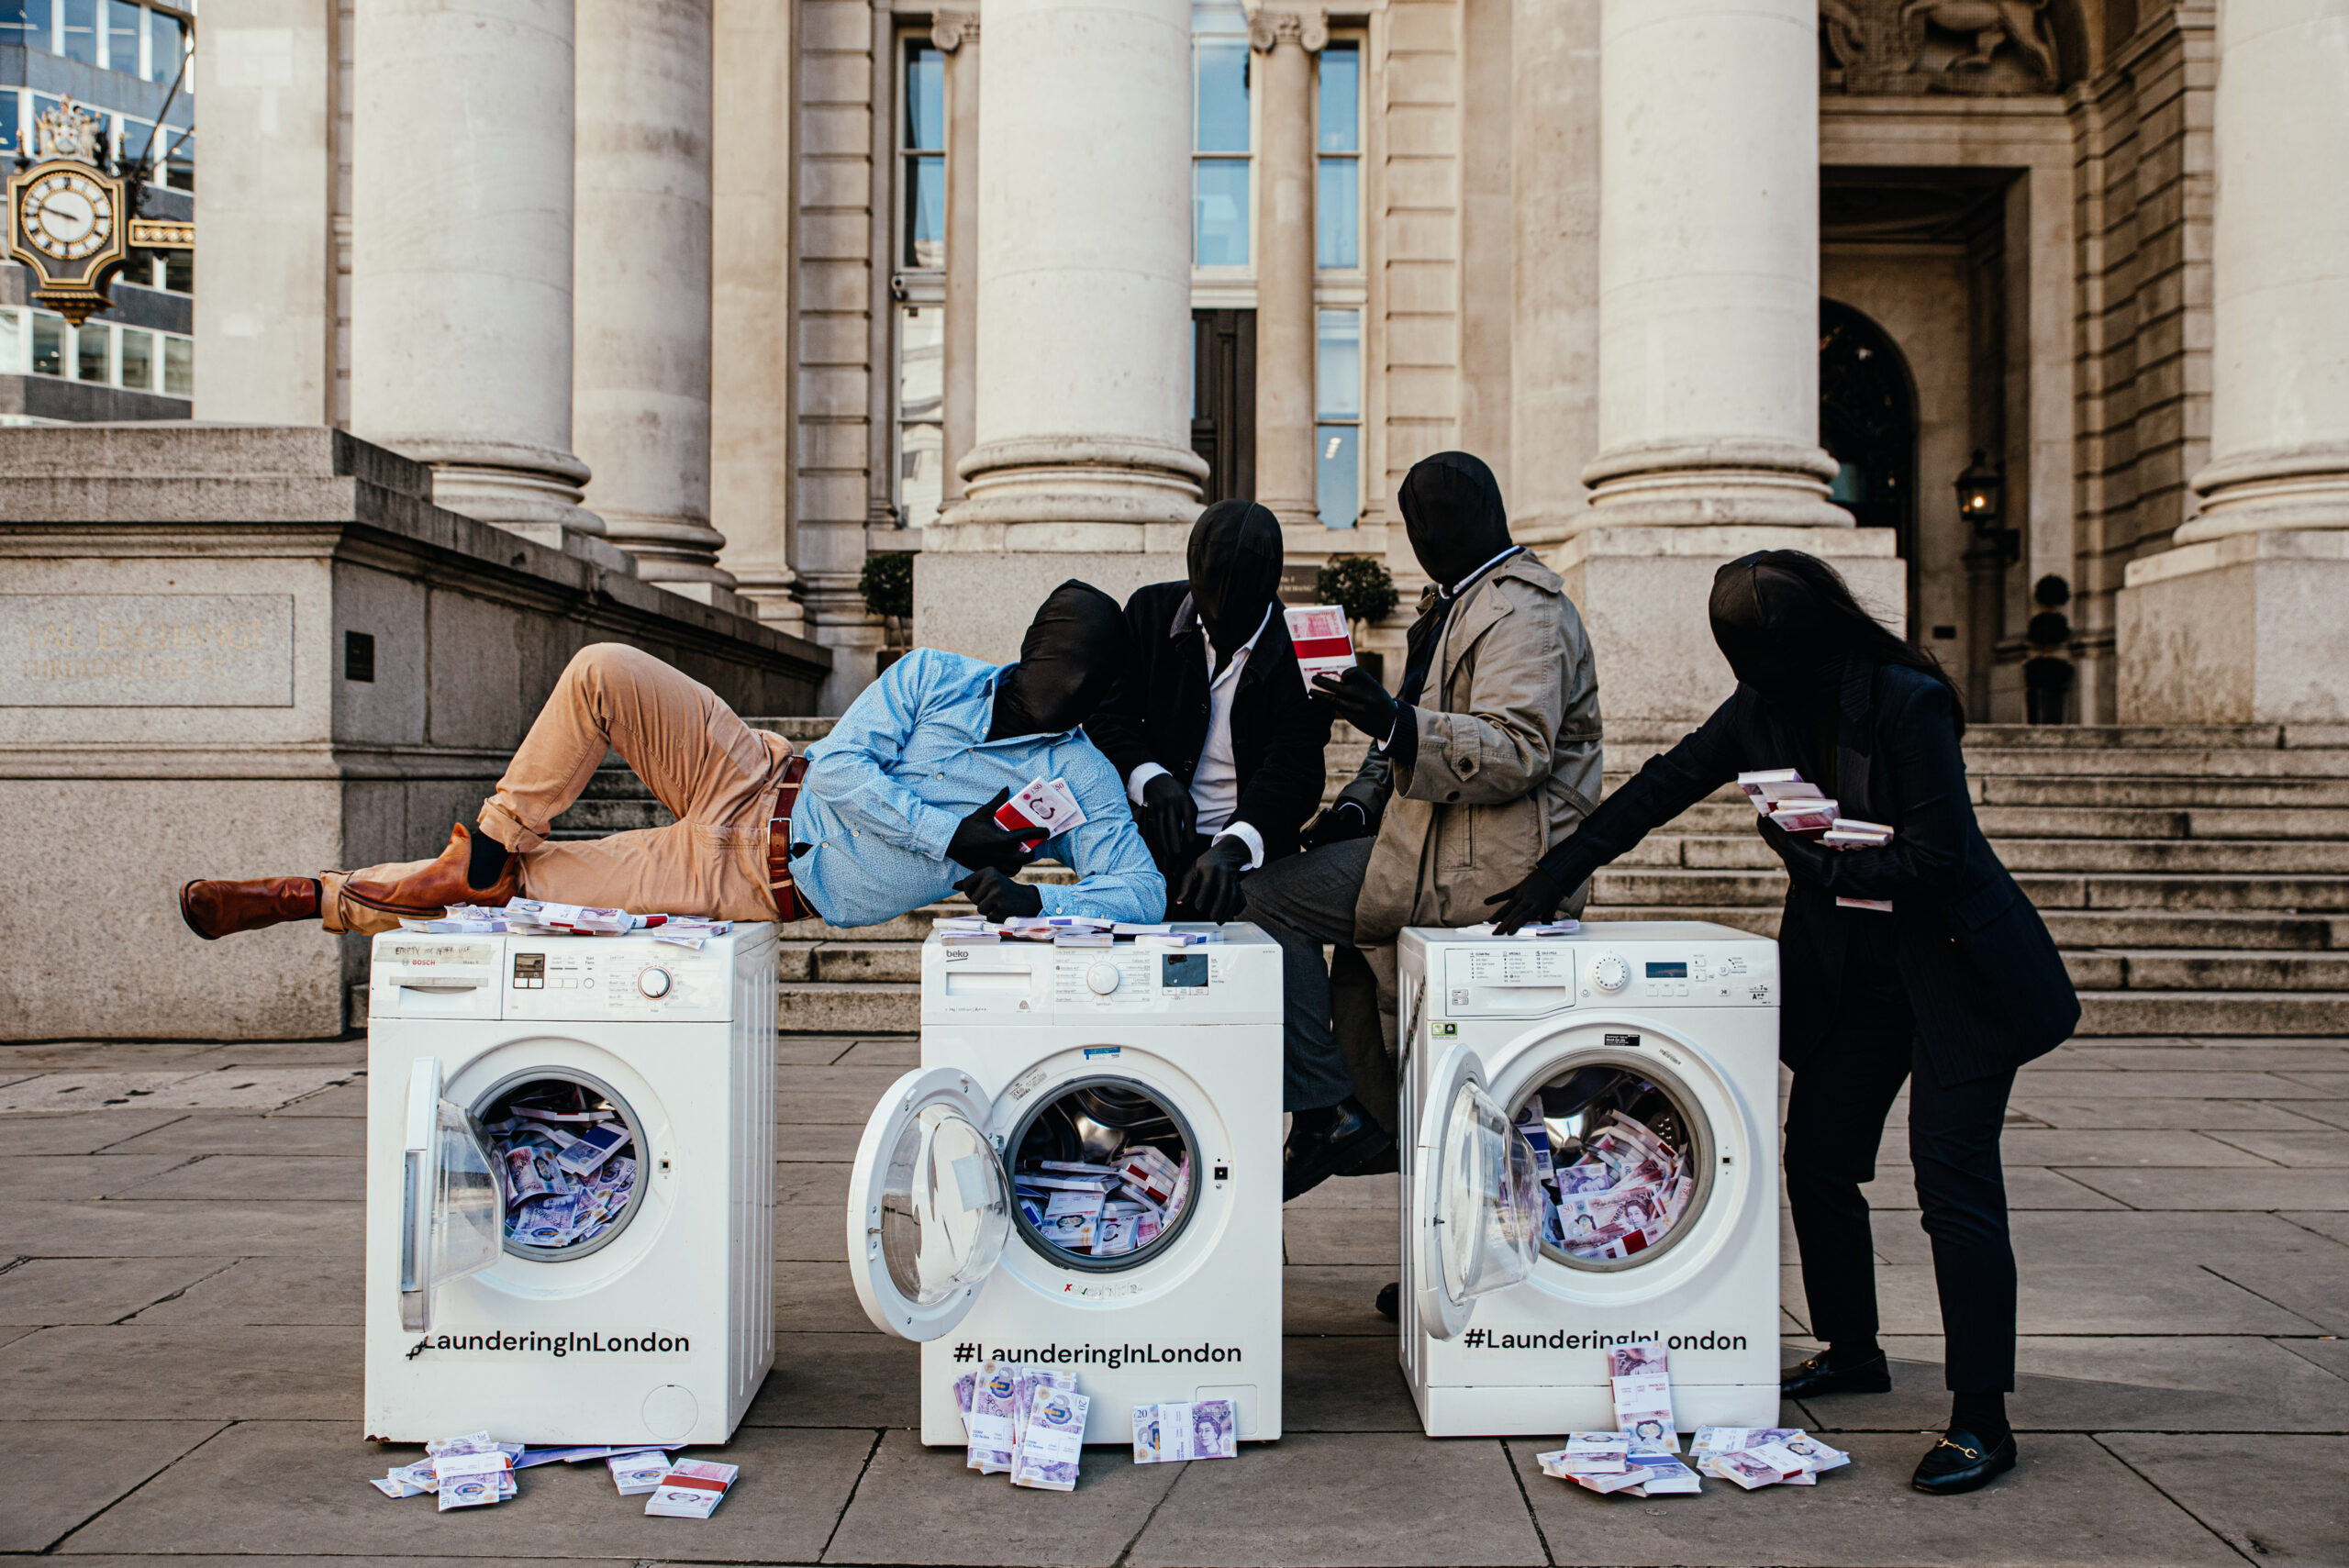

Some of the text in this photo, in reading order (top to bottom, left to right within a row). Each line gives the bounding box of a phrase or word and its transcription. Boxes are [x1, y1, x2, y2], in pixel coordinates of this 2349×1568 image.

[97, 621, 266, 650] EXCHANGE
[22, 658, 228, 679] THREADNEEDLE ST
[946, 949, 969, 958] beko
[953, 1342, 1241, 1369] #LaunderingInLondon
